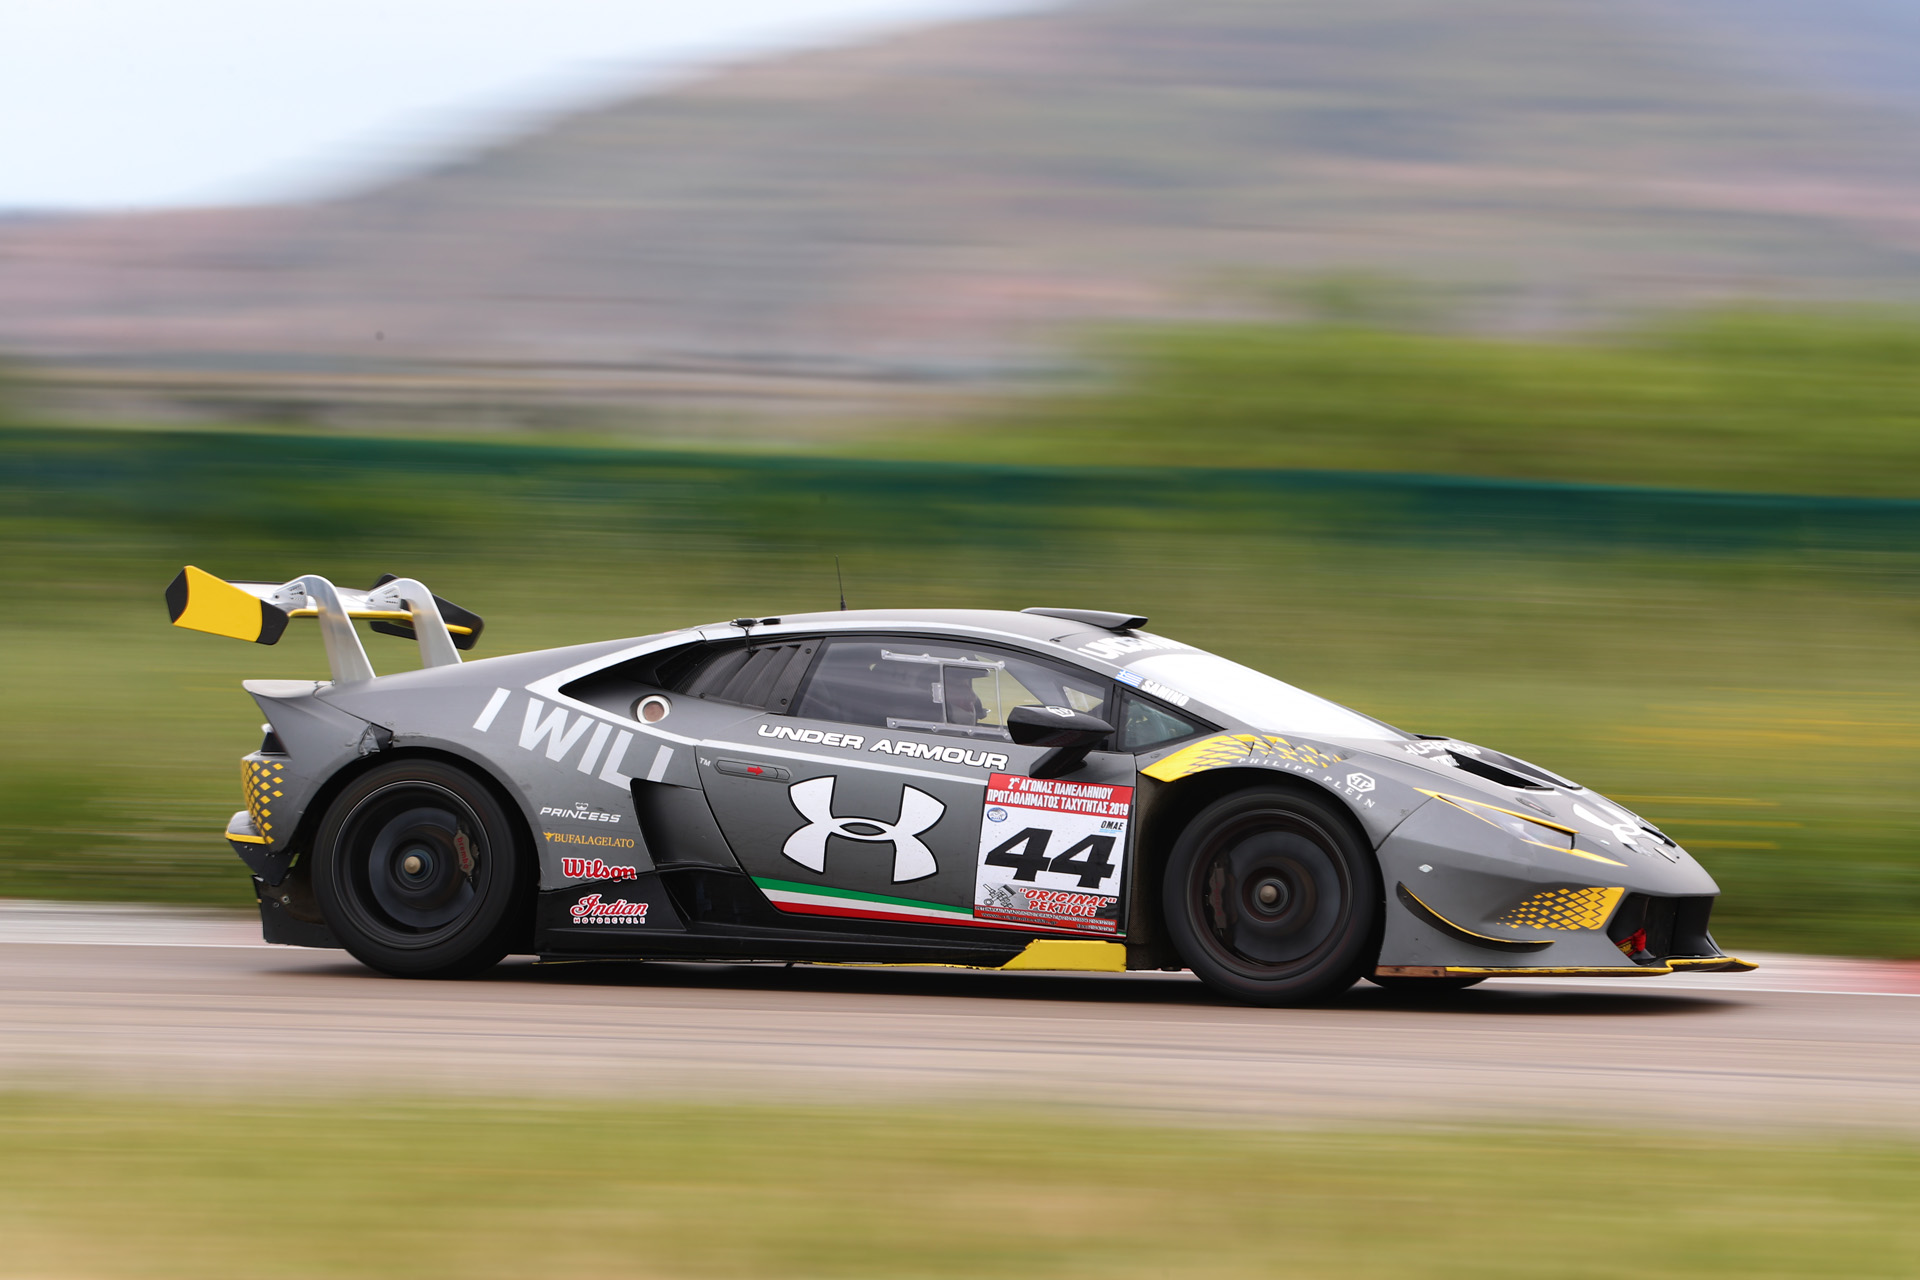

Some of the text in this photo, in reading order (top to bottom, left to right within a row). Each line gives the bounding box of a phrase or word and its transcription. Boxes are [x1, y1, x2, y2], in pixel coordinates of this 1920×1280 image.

[473, 687, 511, 732] I
[757, 724, 1009, 771] UNDER ARMOUR
[700, 757, 711, 766] TM
[1019, 778, 1054, 794] ΑΓΩΝΑΣ
[1054, 781, 1114, 800] ΠΑΝΕΛΛΗΝΙΟΥ
[1238, 758, 1375, 808] PHILIPP PLEIN
[987, 789, 1129, 816] ΠΡΩΤΑΘΛΗΜΑΤΟΣ ΤΑΧΥΤΗΤΑΣ 2019
[540, 807, 621, 823] PRINCESS
[554, 832, 635, 849] BUFALAGELATO
[561, 857, 638, 882] Wilson
[984, 827, 1117, 889] 44
[570, 893, 649, 917] Indian
[573, 917, 646, 925] MOTORCYCLE
